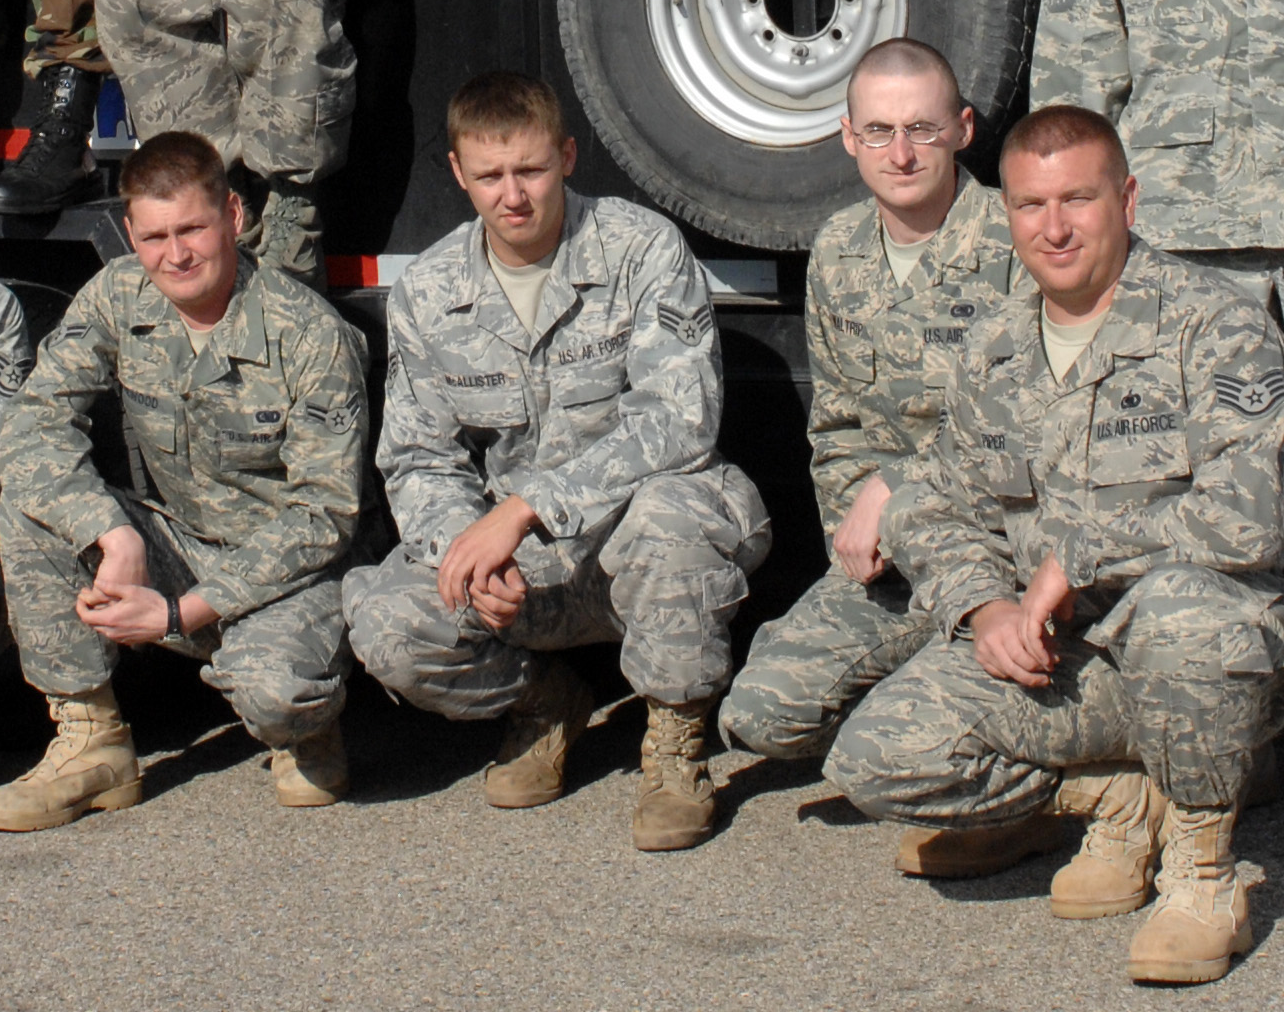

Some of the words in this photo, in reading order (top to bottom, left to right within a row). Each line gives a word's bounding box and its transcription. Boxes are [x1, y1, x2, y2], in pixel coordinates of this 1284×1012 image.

[923, 328, 944, 344] U.S.
[946, 328, 964, 344] AIR
[558, 349, 576, 366] U.S.
[581, 344, 595, 361] AIR
[598, 328, 632, 356] FORCE
[1096, 424, 1112, 439] U.S.
[1115, 418, 1131, 436] AIR
[1133, 413, 1177, 434] FORCE
[981, 433, 1006, 450] PIPER
